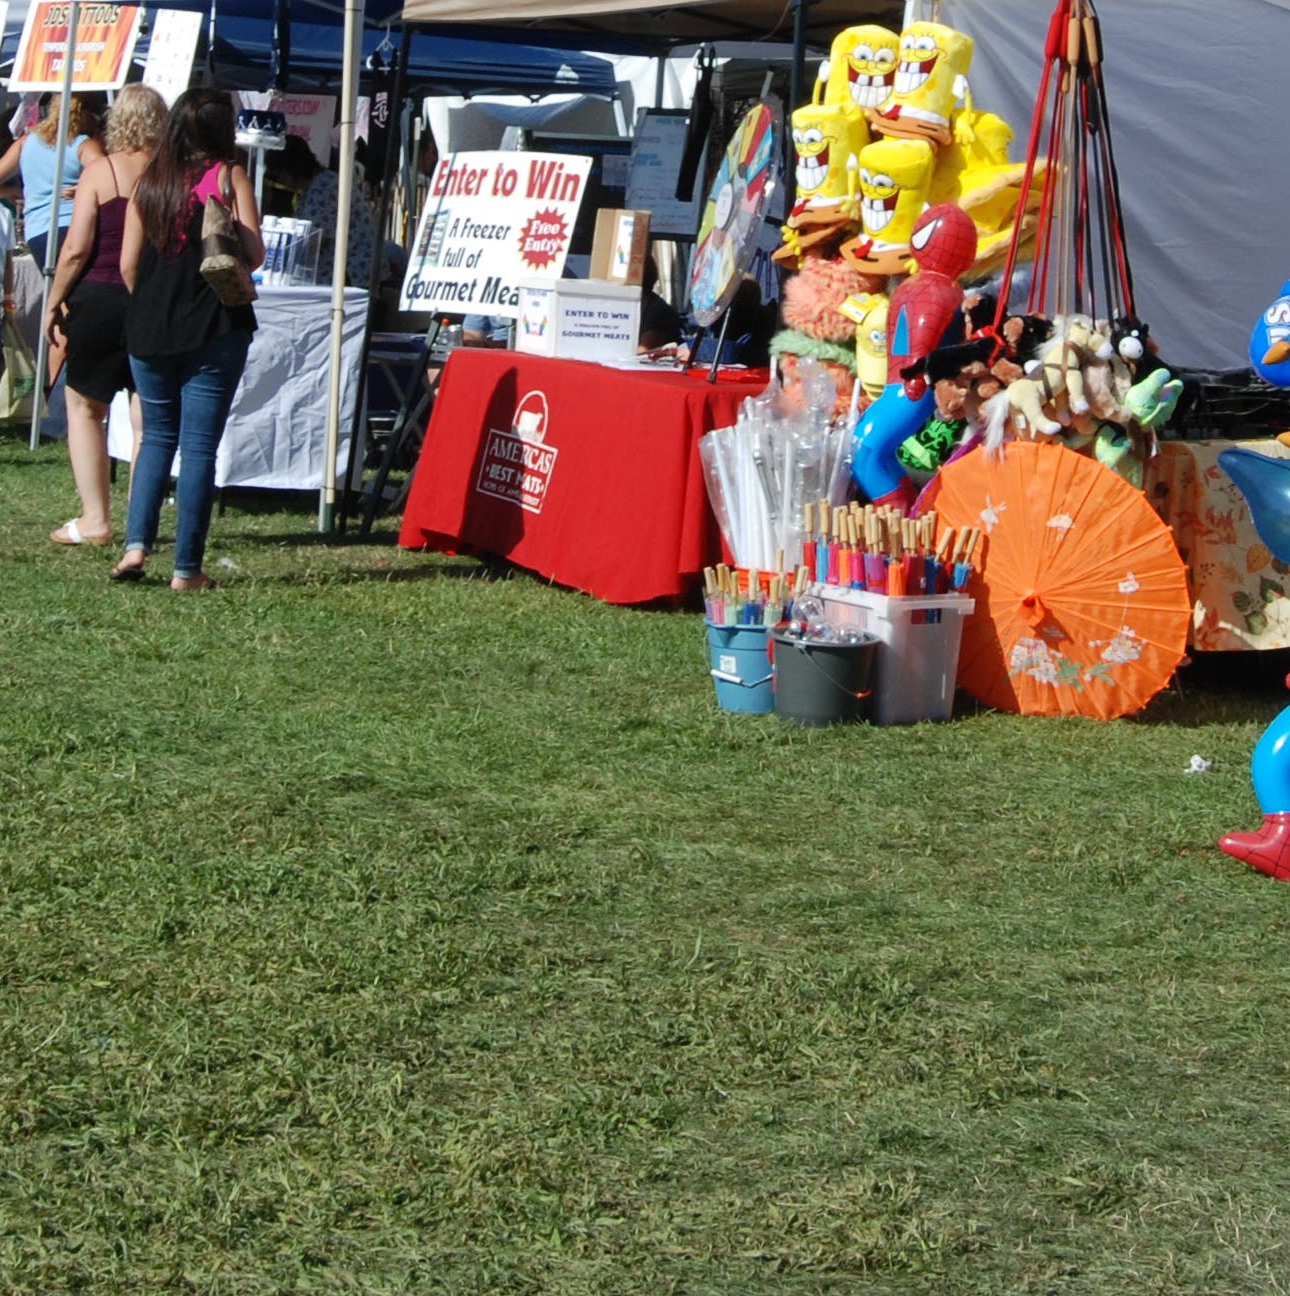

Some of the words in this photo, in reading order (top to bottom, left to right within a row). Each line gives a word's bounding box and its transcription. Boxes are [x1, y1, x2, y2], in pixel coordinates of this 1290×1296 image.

[77, 5, 122, 25] TTOOS
[432, 160, 489, 197] Enter
[491, 162, 519, 197] to
[525, 159, 581, 202] Win
[448, 217, 461, 238] A
[461, 217, 511, 240] Freezer
[528, 220, 561, 236] Free
[523, 238, 563, 255] Entry
[441, 247, 466, 268] full
[466, 248, 484, 268] of
[405, 273, 478, 301] Gourmet
[479, 276, 519, 306] Mea
[565, 309, 595, 317] ENTER
[597, 311, 609, 319] TO
[611, 312, 629, 320] WIN
[562, 331, 601, 339] GOURMET
[603, 332, 630, 341] MEATS
[489, 464, 515, 483] BEST
[516, 471, 543, 494] MATS
